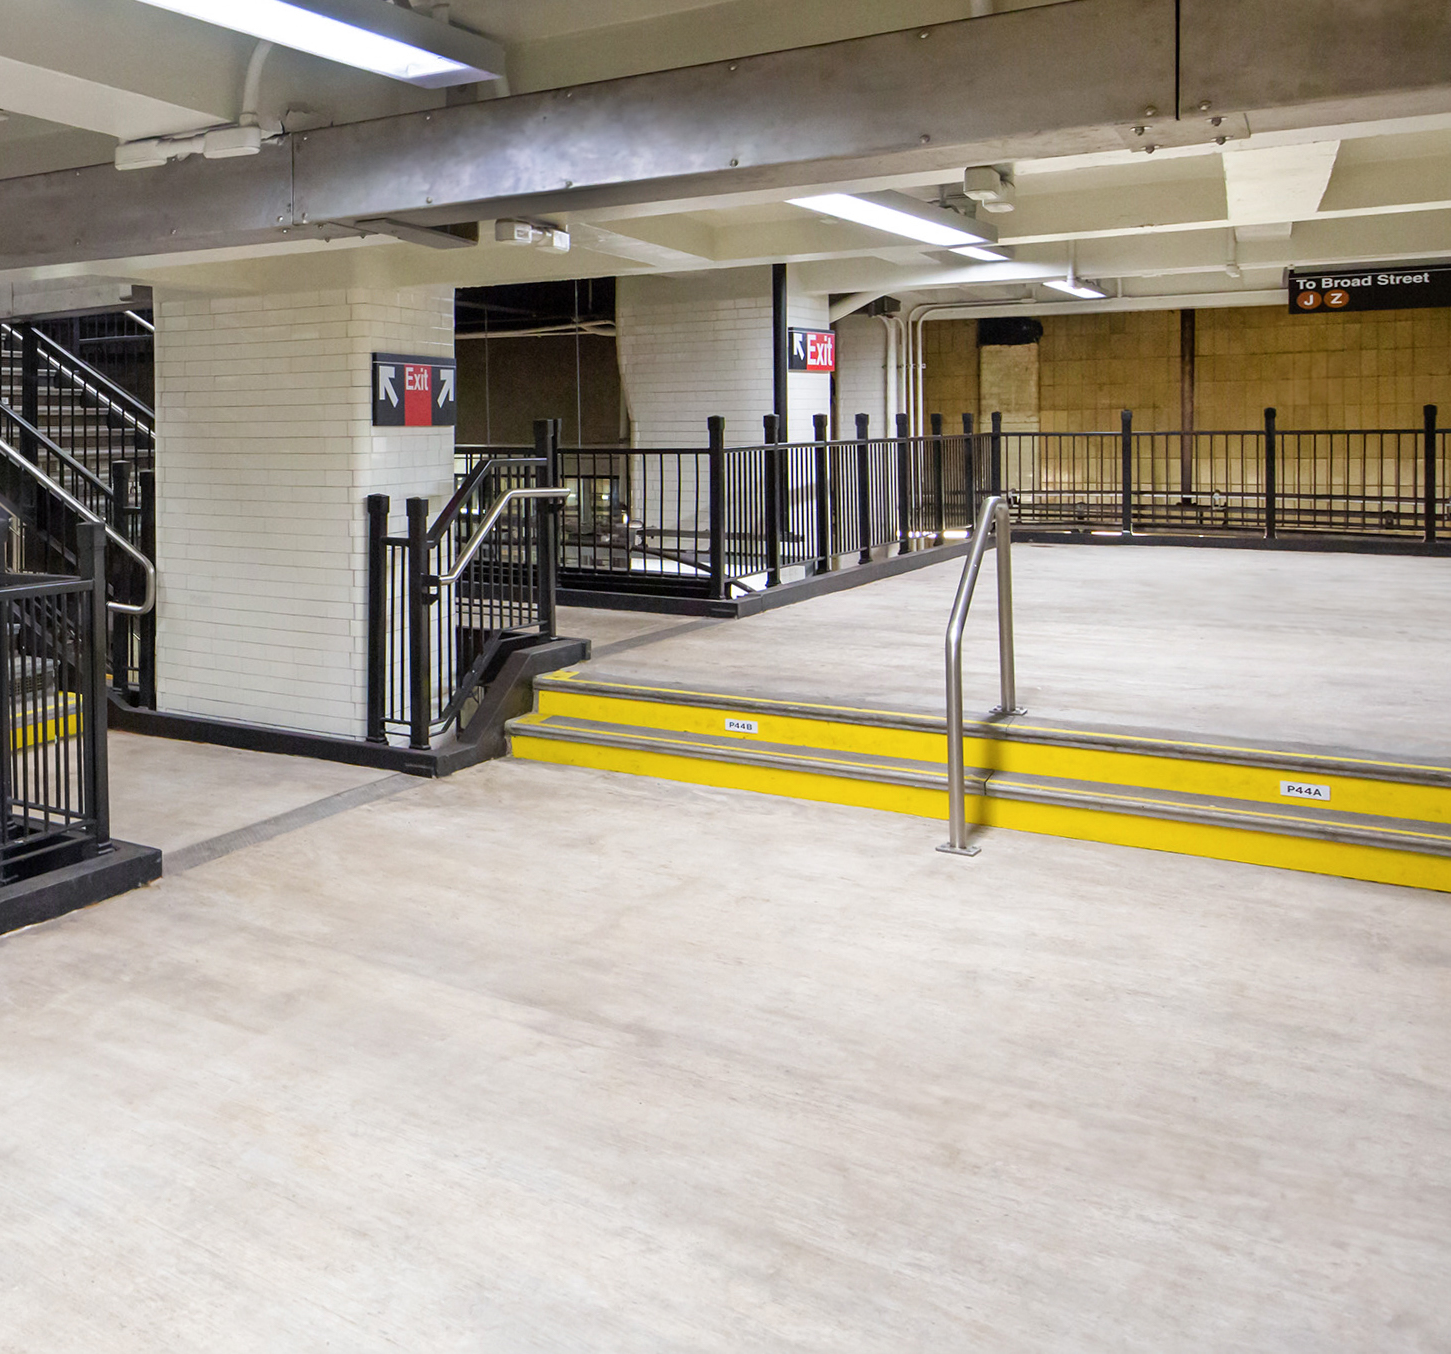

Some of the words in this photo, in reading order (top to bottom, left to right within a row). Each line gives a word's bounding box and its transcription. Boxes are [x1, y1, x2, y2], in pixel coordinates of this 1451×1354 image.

[1296, 279, 1316, 290] To
[1321, 275, 1372, 289] Broad
[1377, 272, 1430, 286] Street
[1304, 294, 1314, 306] J
[1330, 292, 1343, 304] Z
[807, 334, 833, 366] Exit
[405, 367, 429, 391] Exit
[729, 721, 753, 731] P44B
[1287, 785, 1322, 797] P44A
